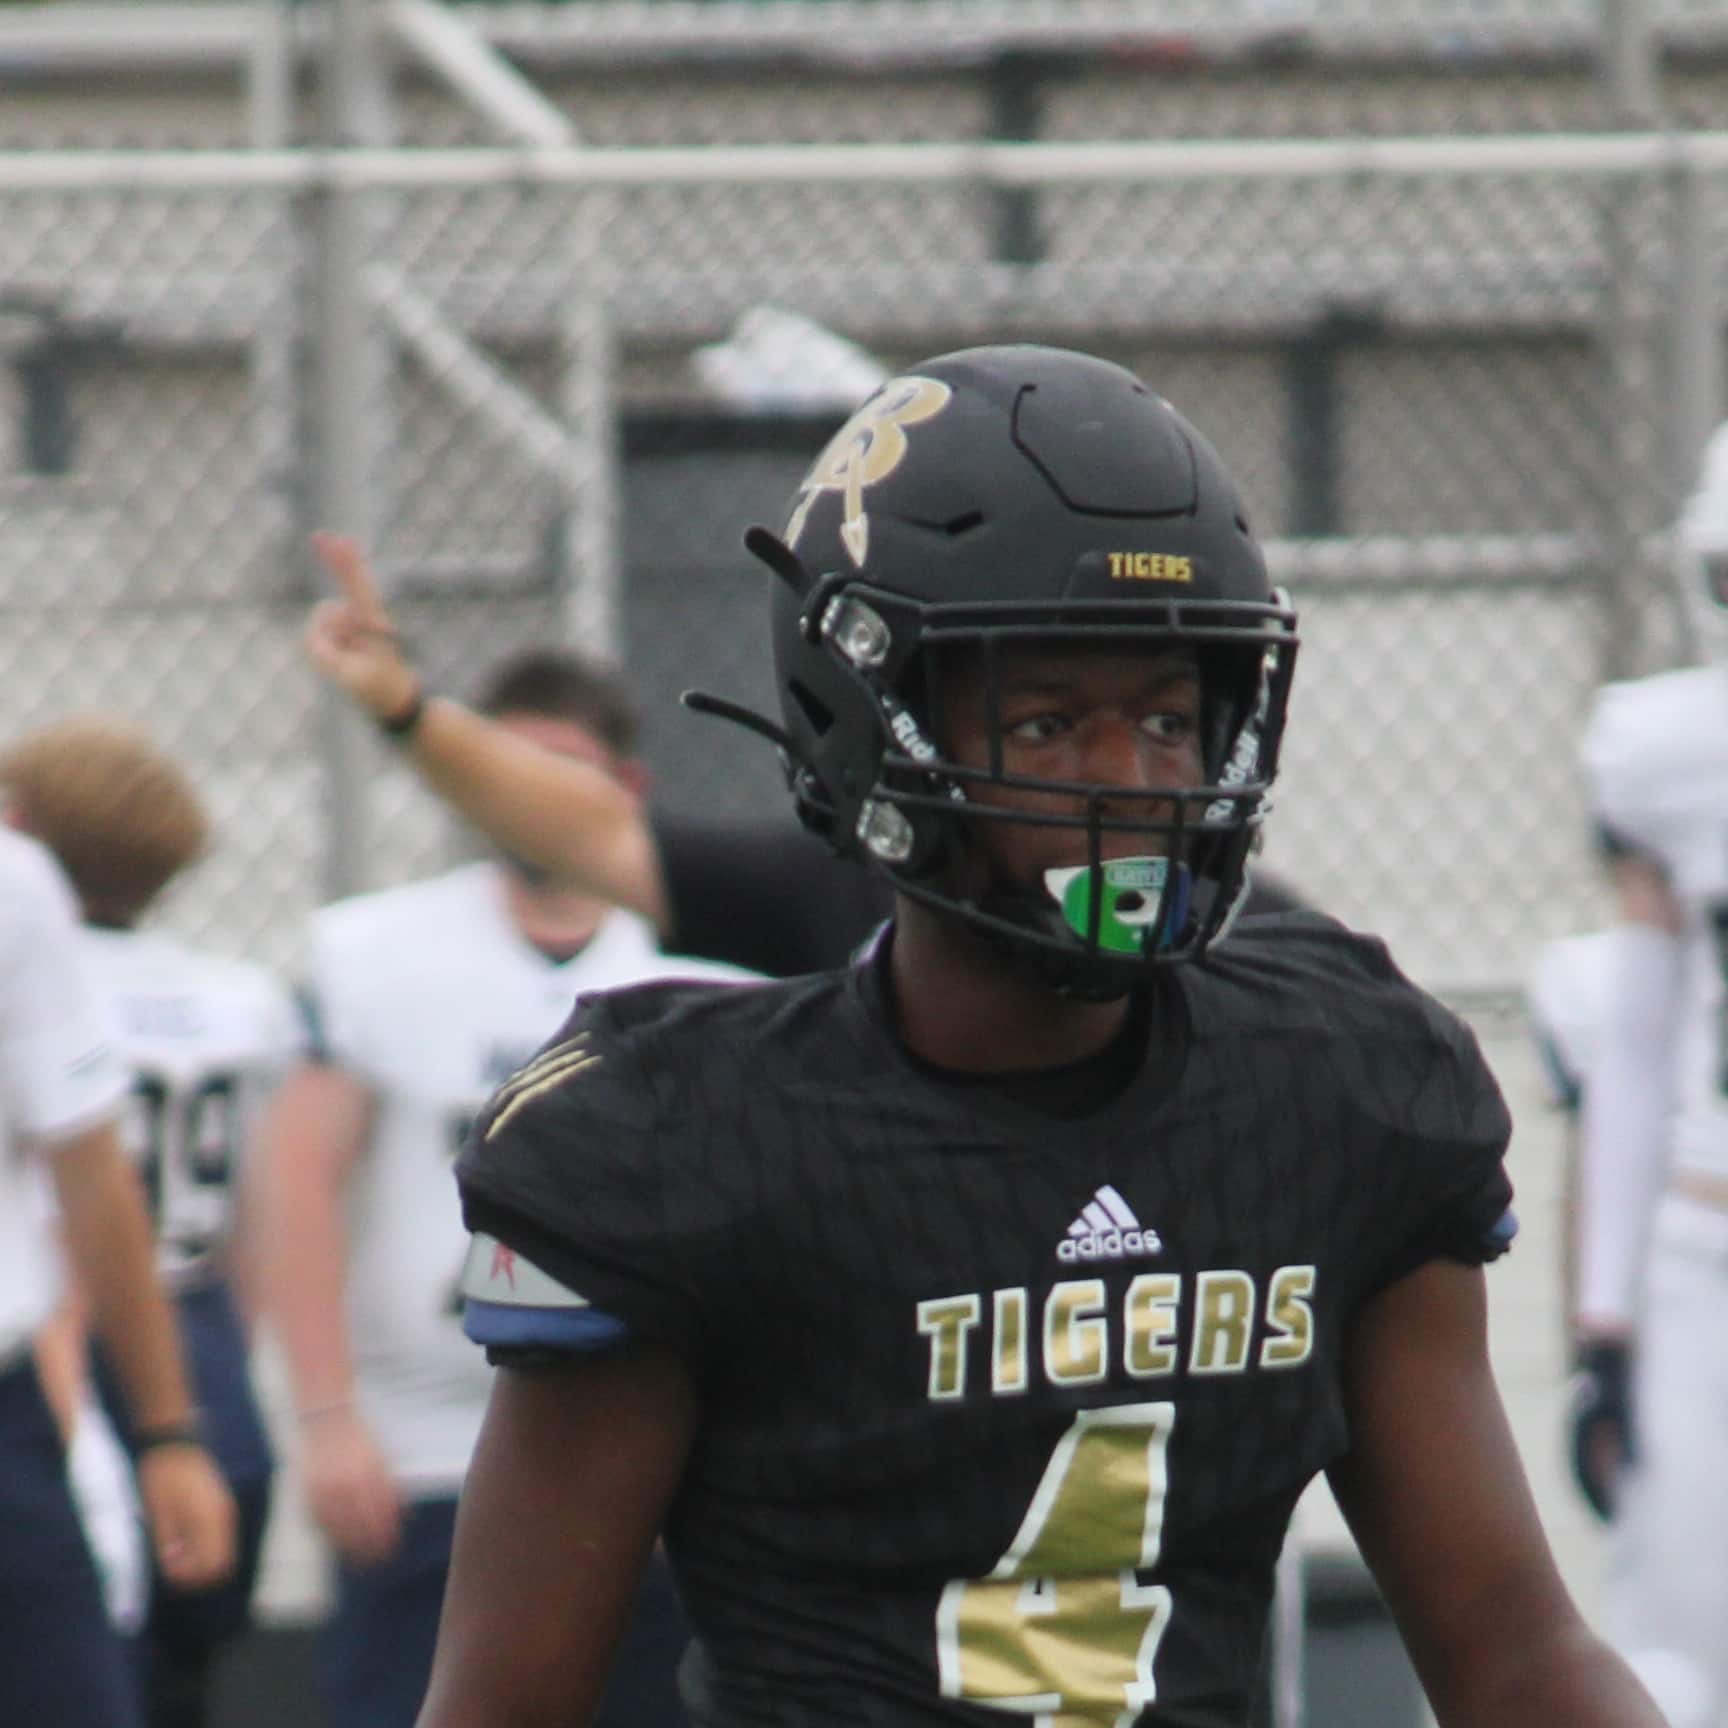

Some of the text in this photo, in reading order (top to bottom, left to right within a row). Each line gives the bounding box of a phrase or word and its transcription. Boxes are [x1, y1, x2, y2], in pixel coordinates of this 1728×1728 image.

[1106, 551, 1193, 583] TIGERS
[1056, 1228, 1162, 1261] adidas
[917, 1264, 1316, 1400] TIGERS
